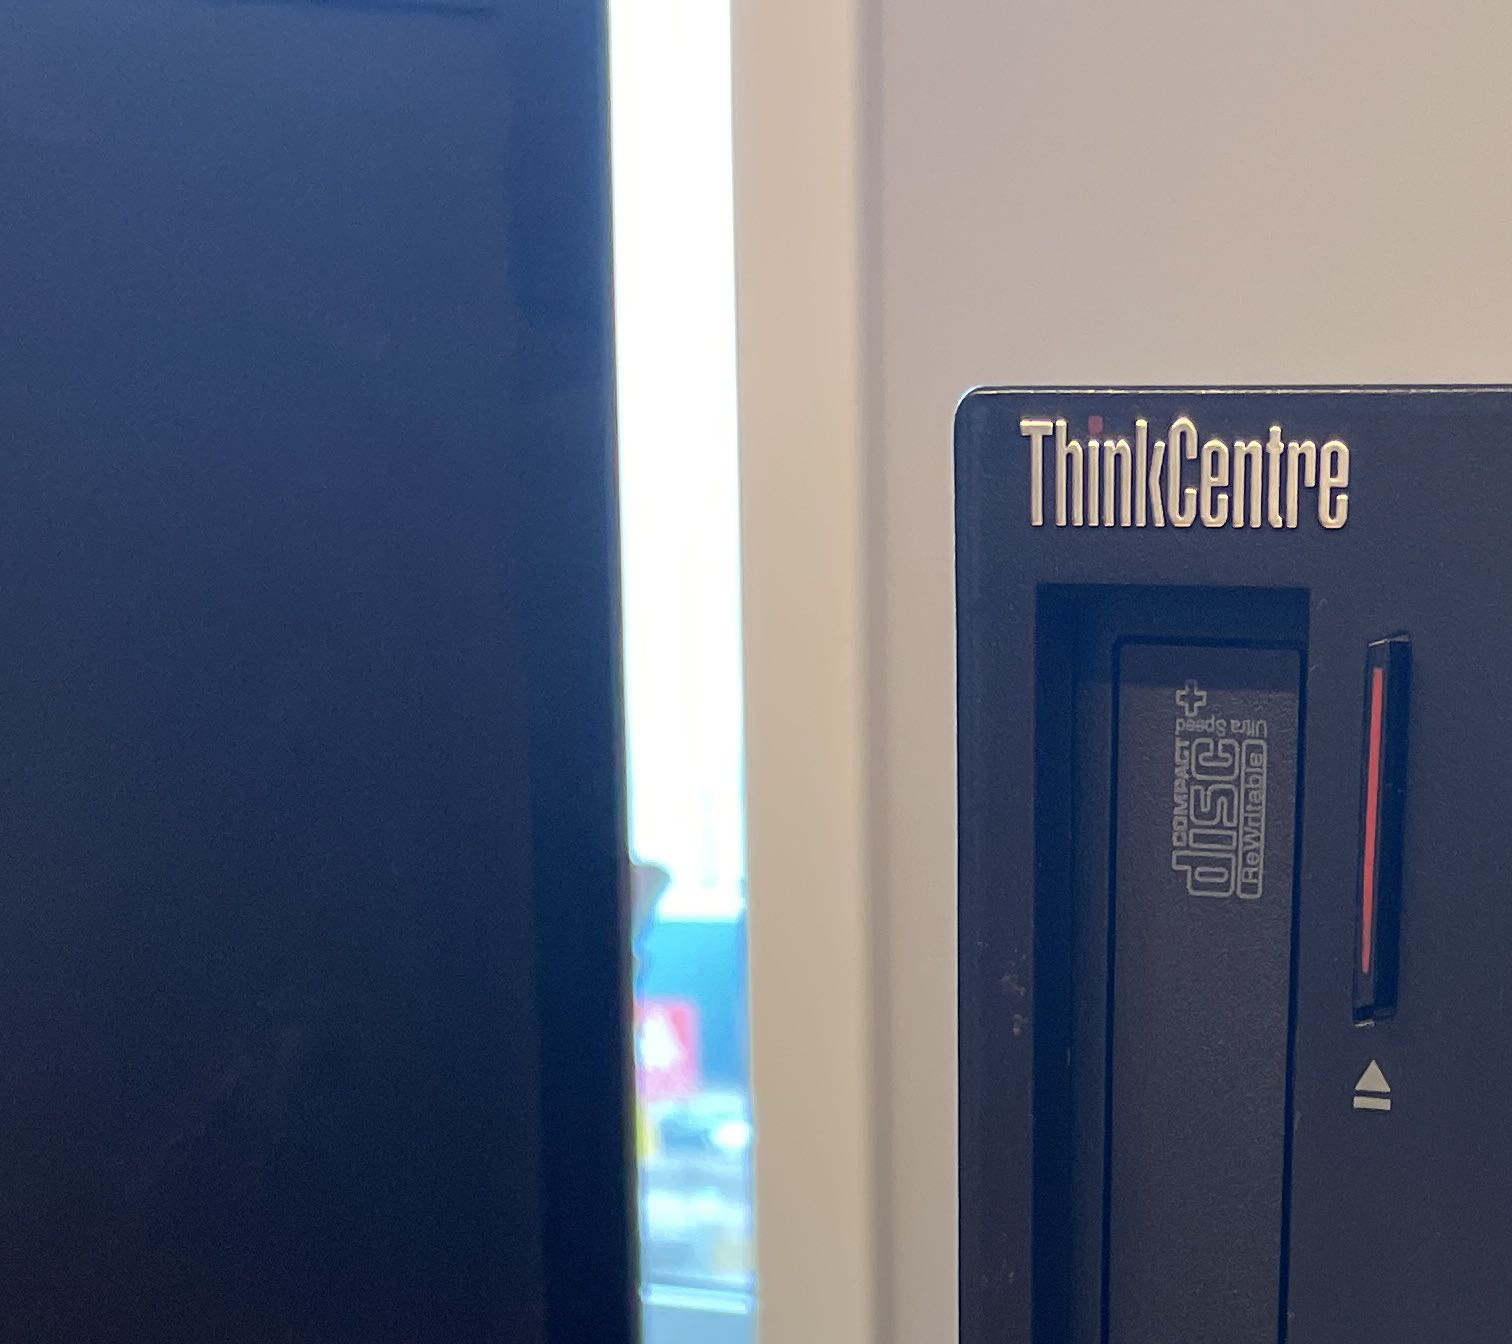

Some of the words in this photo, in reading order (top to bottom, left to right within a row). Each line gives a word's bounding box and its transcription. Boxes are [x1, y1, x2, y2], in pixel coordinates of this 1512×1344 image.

[1020, 416, 1349, 528] ThinkCentre
[1175, 715, 1227, 737] Speed
[1171, 738, 1241, 897] disc
[1172, 737, 1190, 847] COMPACT
[1241, 752, 1264, 884] ReWritable
